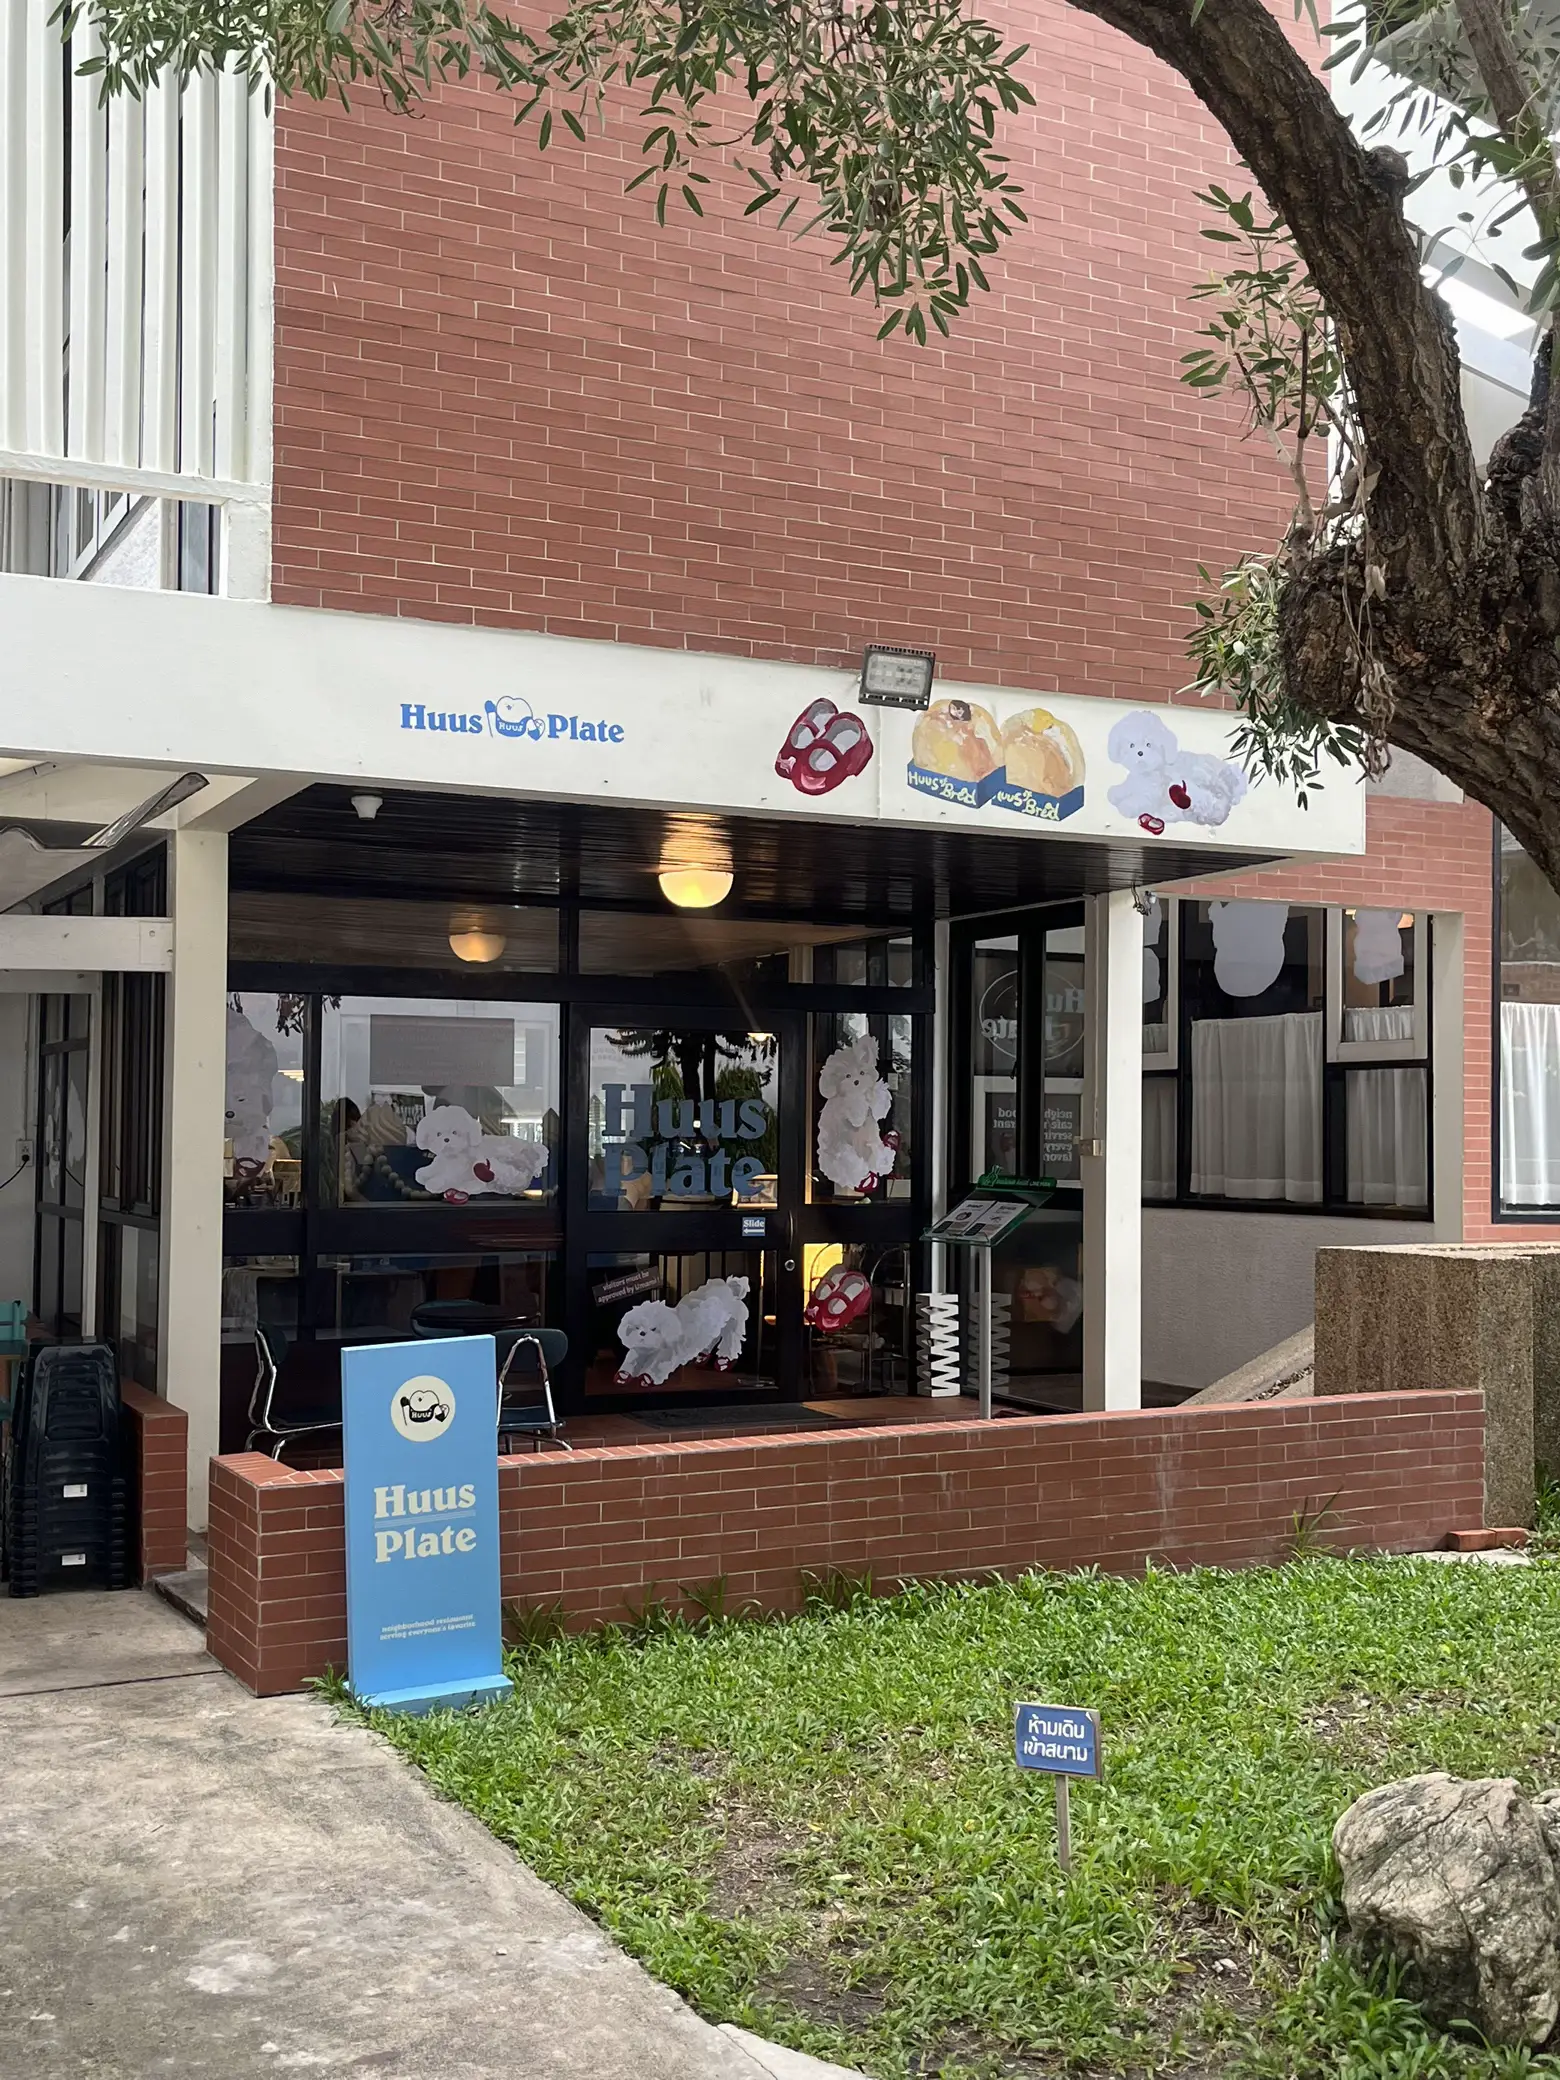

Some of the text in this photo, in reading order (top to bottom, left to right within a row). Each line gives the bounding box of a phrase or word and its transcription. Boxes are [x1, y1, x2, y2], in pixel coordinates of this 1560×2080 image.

[400, 703, 625, 743] Huus Plate
[602, 1083, 767, 1140] Huus
[602, 1143, 767, 1197] Plate
[743, 1219, 765, 1228] Slide
[373, 1483, 476, 1519] Huus
[374, 1525, 477, 1563] Plate
[1028, 1713, 1085, 1739] ห้ามเดิน
[1023, 1735, 1088, 1762] เข้าสนาม
